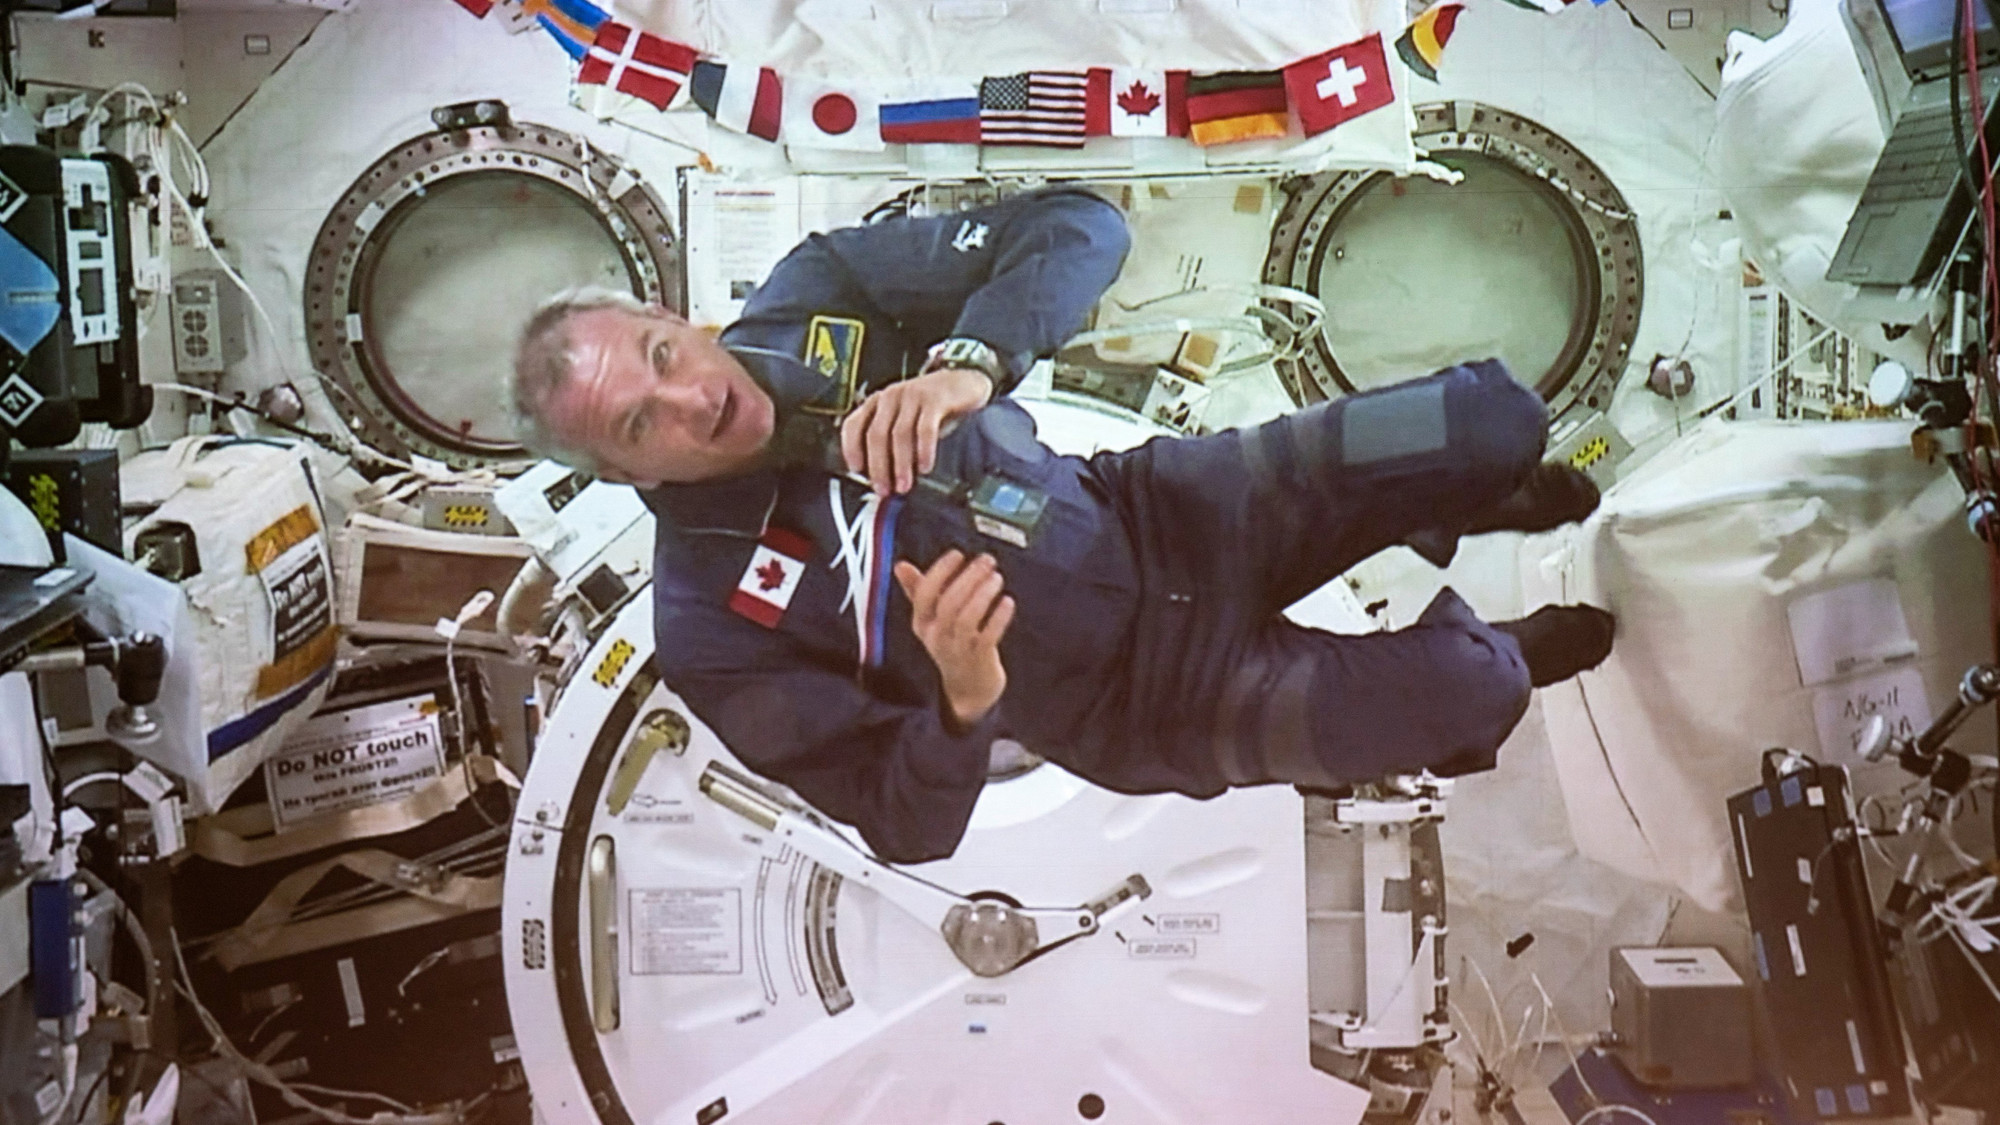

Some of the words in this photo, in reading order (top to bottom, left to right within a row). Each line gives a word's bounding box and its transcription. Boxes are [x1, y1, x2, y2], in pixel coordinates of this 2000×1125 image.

[277, 759, 306, 777] Do
[313, 745, 358, 768] NOT
[368, 731, 428, 757] touch
